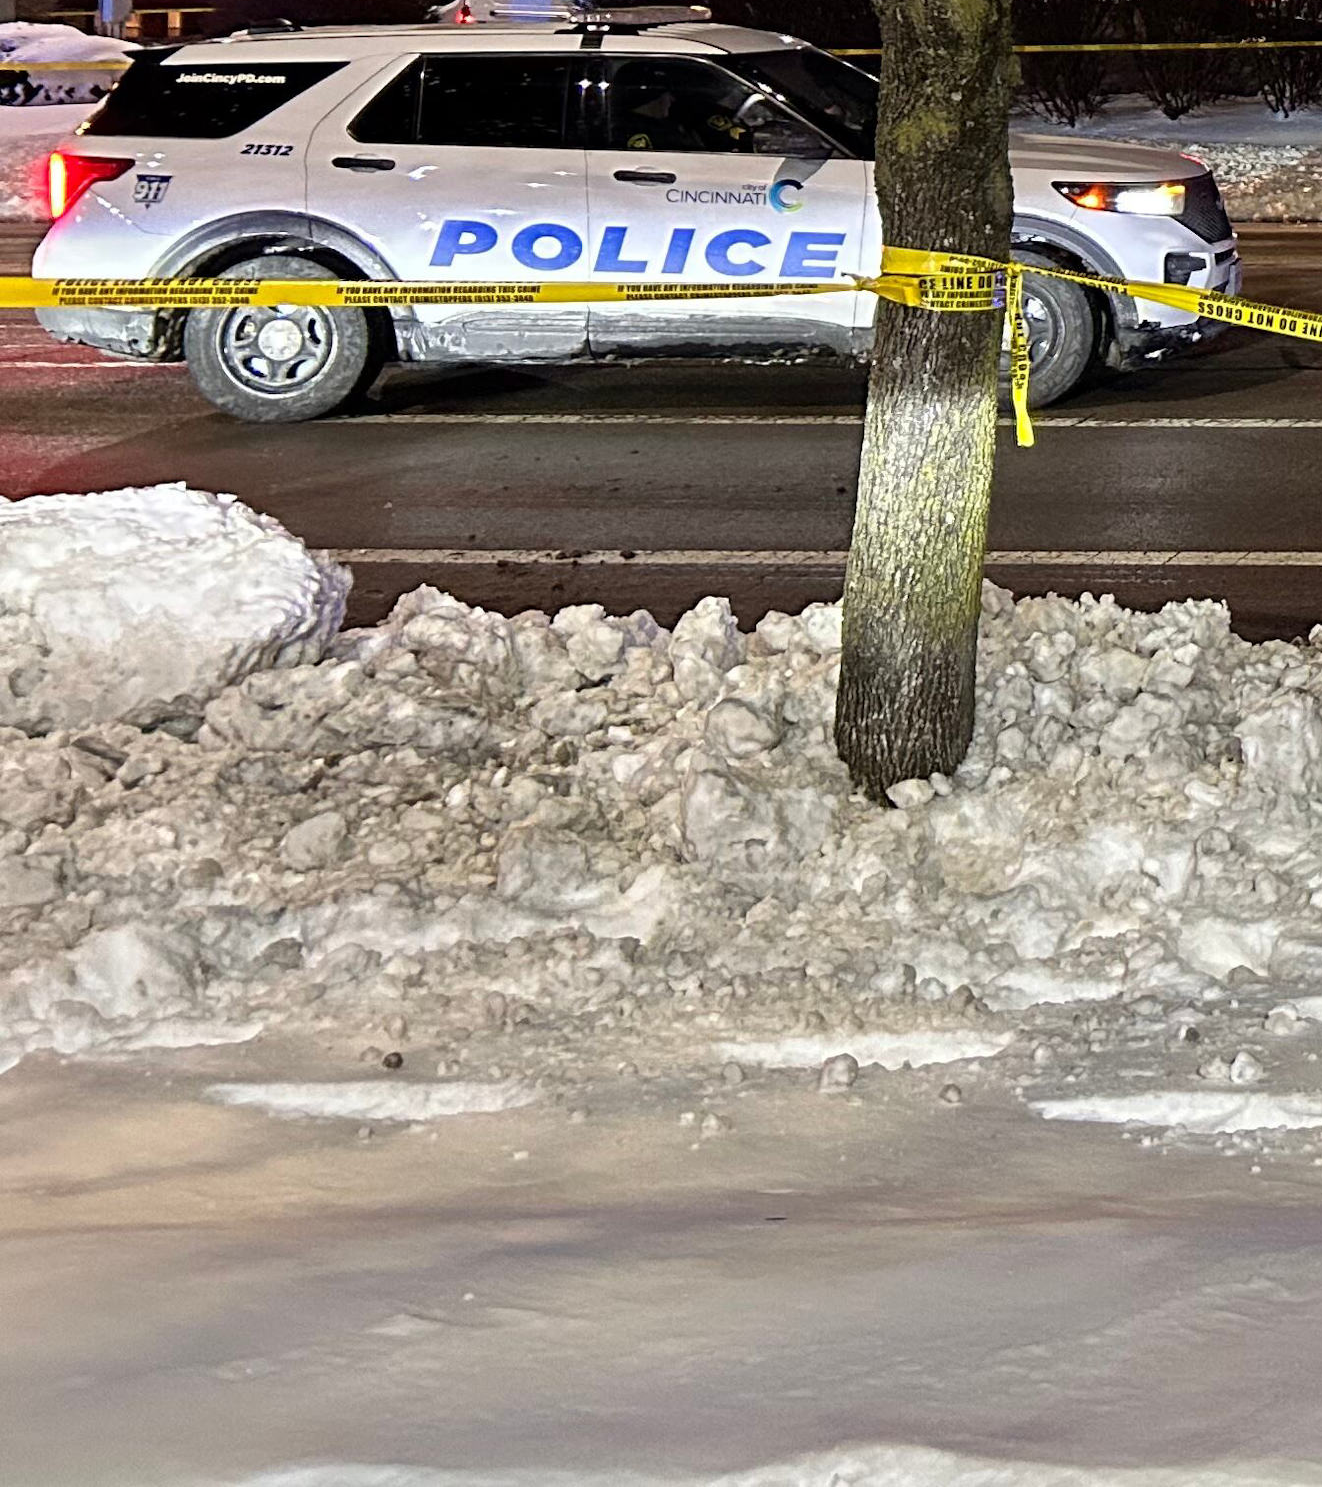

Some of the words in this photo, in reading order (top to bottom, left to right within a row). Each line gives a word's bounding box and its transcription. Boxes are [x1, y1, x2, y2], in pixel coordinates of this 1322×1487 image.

[175, 73, 286, 85] JoinCincyPD.com
[240, 143, 294, 156] 21312
[133, 180, 170, 203] 911
[741, 183, 757, 191] city
[758, 183, 768, 191] of
[665, 188, 767, 205] CINCINNATI
[428, 219, 847, 278] POLICE
[942, 276, 973, 289] LINE
[1197, 301, 1243, 321] CROSS
[1247, 311, 1274, 328] NOT
[1279, 318, 1297, 332] DO
